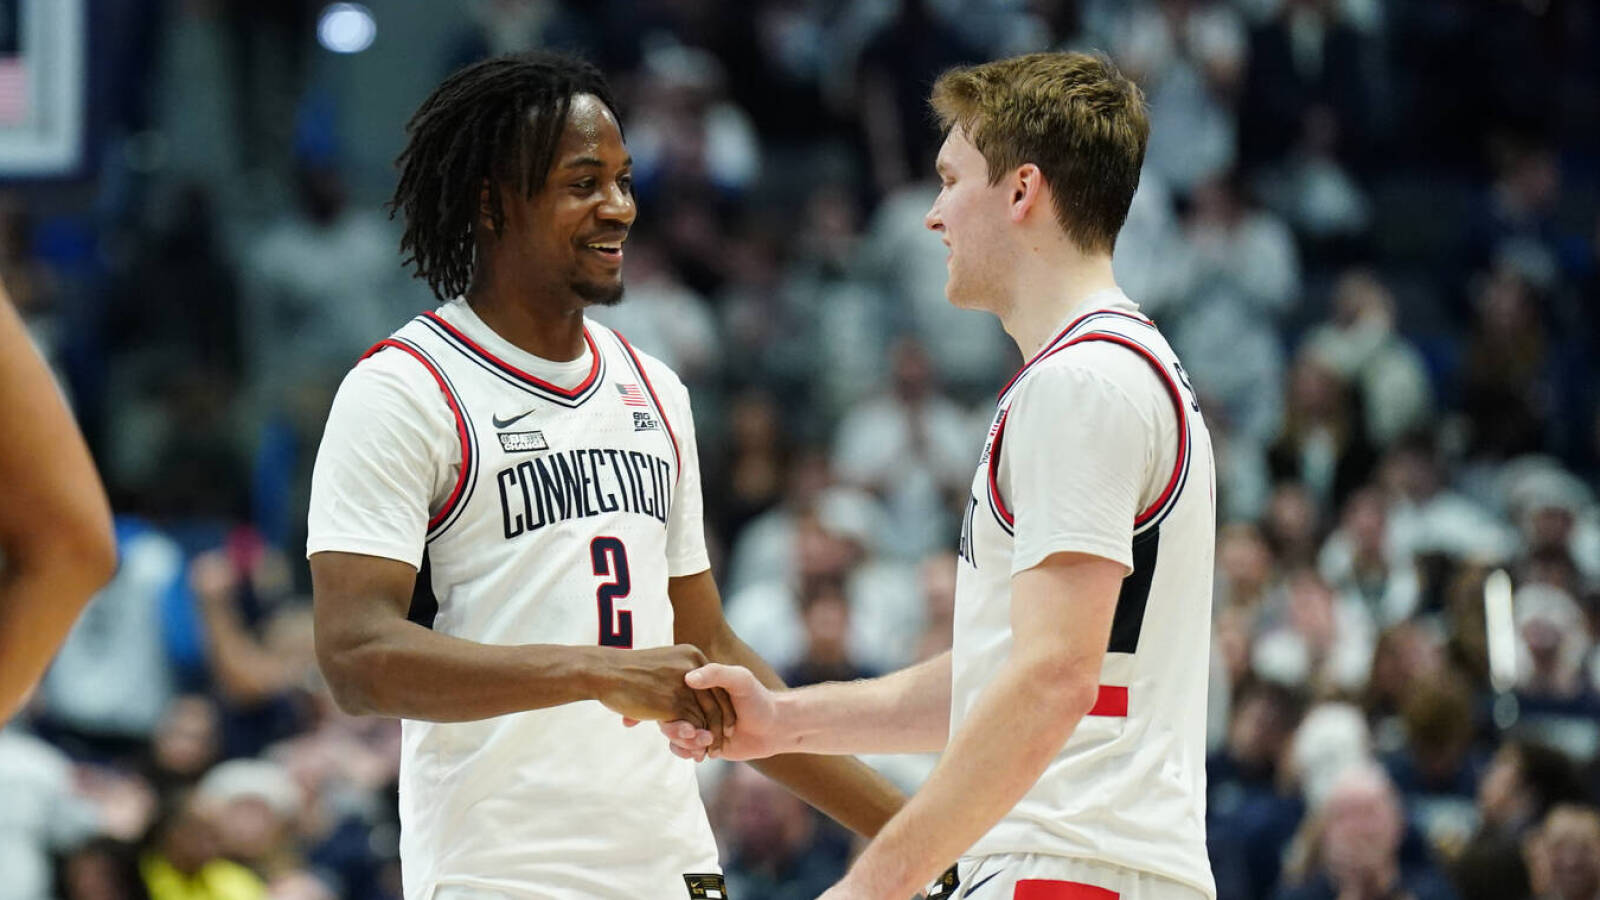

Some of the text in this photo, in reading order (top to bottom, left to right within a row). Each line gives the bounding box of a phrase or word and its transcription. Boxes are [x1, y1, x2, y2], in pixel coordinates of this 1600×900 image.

[633, 411, 650, 420] BIG
[634, 420, 658, 428] EAST
[497, 449, 670, 539] CONNECTICUT
[590, 536, 633, 649] 2
